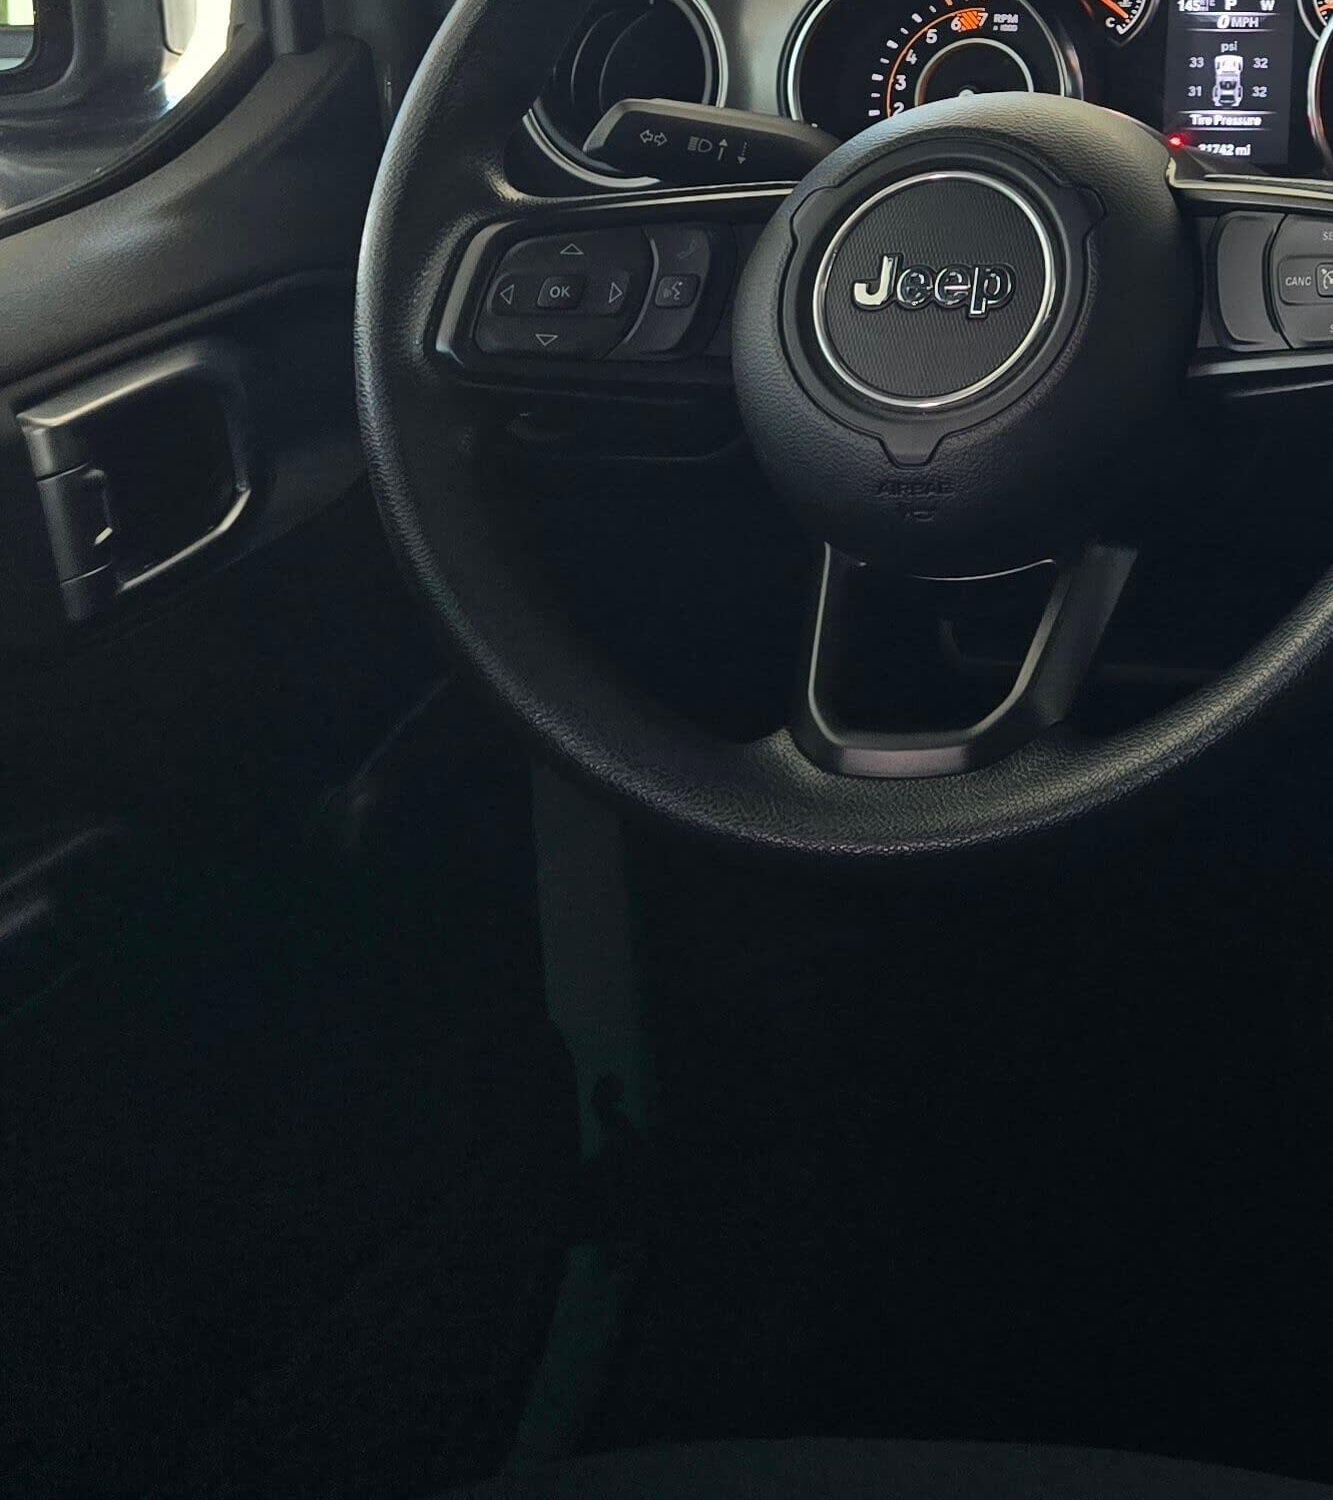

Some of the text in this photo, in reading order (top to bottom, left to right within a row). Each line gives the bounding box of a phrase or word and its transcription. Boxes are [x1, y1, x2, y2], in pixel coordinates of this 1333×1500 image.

[1177, 0, 1200, 12] 145
[1260, 0, 1276, 11] W
[1231, 16, 1259, 28] MPH
[925, 28, 938, 44] 5
[1220, 41, 1239, 53] psi
[905, 49, 918, 65] 4
[1189, 56, 1205, 68] 33
[1253, 57, 1269, 69] 32
[894, 74, 907, 91] 3
[1188, 85, 1203, 97] 31
[1252, 86, 1268, 98] 32
[1189, 113, 1262, 127] Tire Pressure
[853, 253, 1013, 316] Jeep
[1285, 276, 1312, 287] CANC
[550, 286, 571, 299] OK
